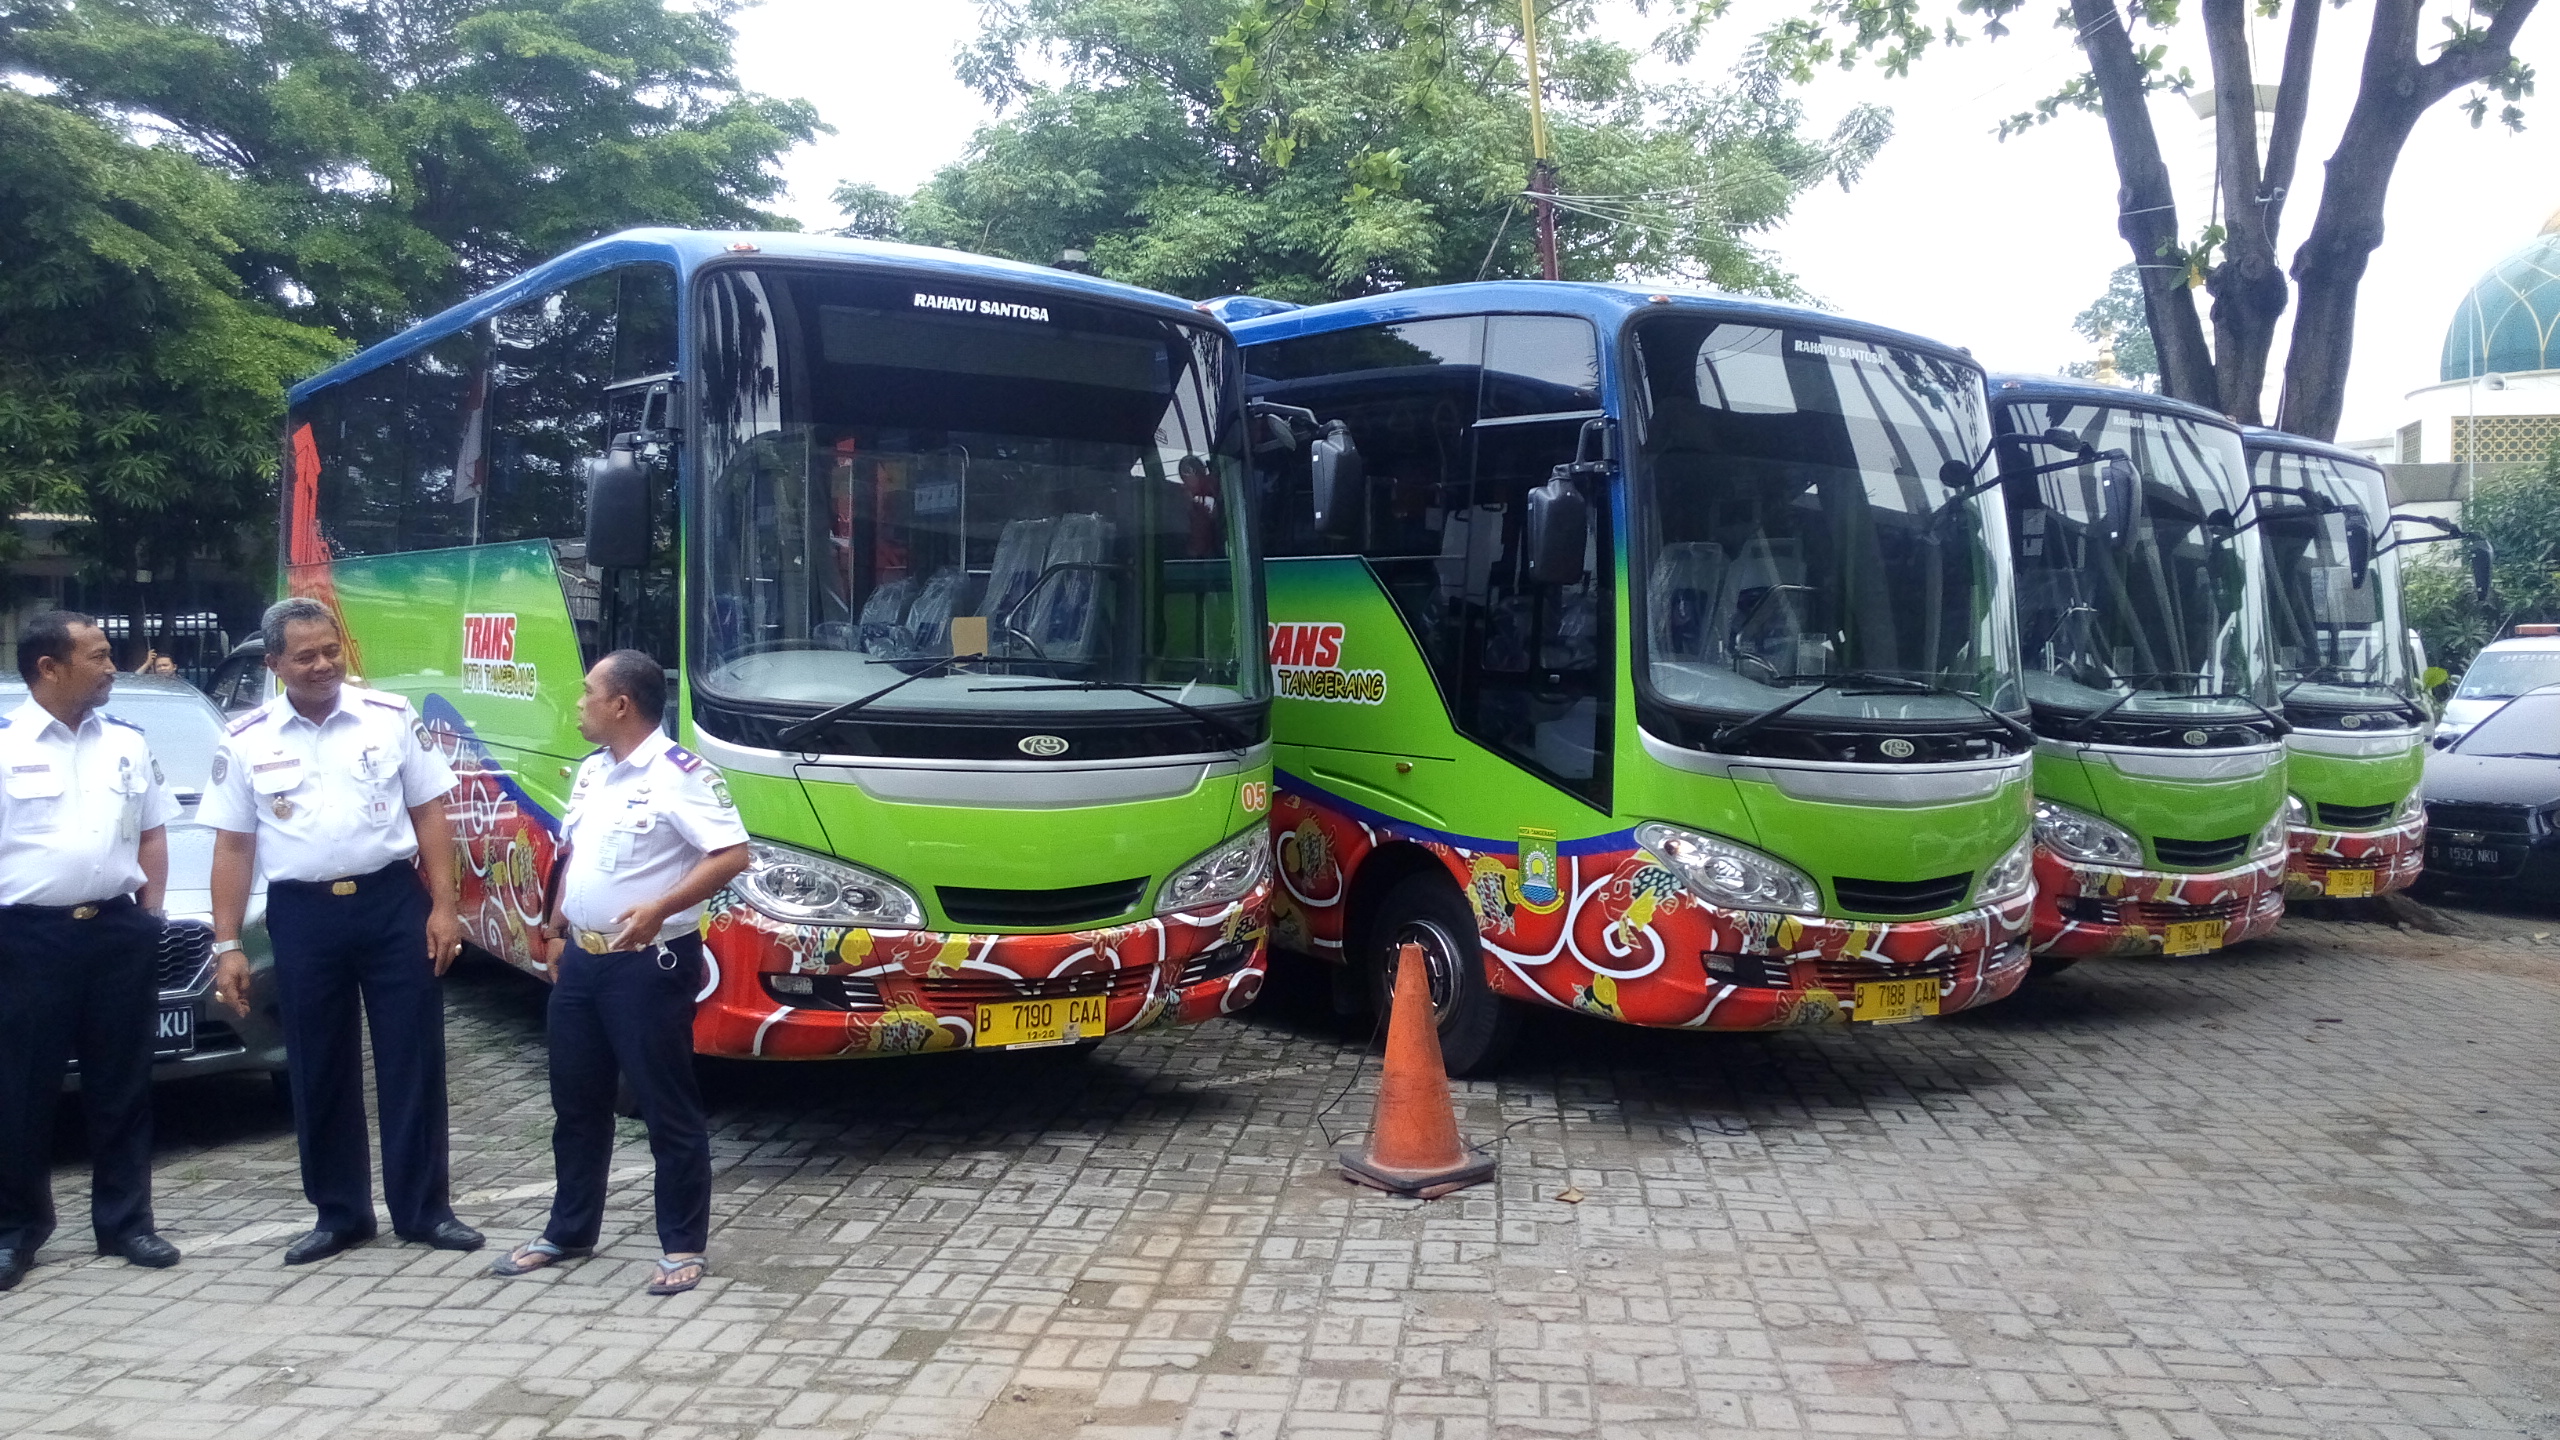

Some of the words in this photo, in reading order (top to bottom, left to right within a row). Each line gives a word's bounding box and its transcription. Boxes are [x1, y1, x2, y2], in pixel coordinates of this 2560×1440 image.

[914, 293, 977, 312] RAHAYU
[980, 300, 1050, 321] SANTOSA
[1795, 340, 1837, 356] RAHAYU
[1839, 346, 1884, 365] SANTOSA
[463, 616, 516, 661] TRANS
[1278, 669, 1384, 701] TANGERANG
[1242, 782, 1267, 812] 05
[1857, 986, 1865, 1008] B
[1879, 984, 1905, 1006] 7188
[1915, 981, 1937, 1003] CAA
[980, 1007, 991, 1032] B
[1012, 1003, 1052, 1030] 7190
[1069, 999, 1101, 1024] CAA
